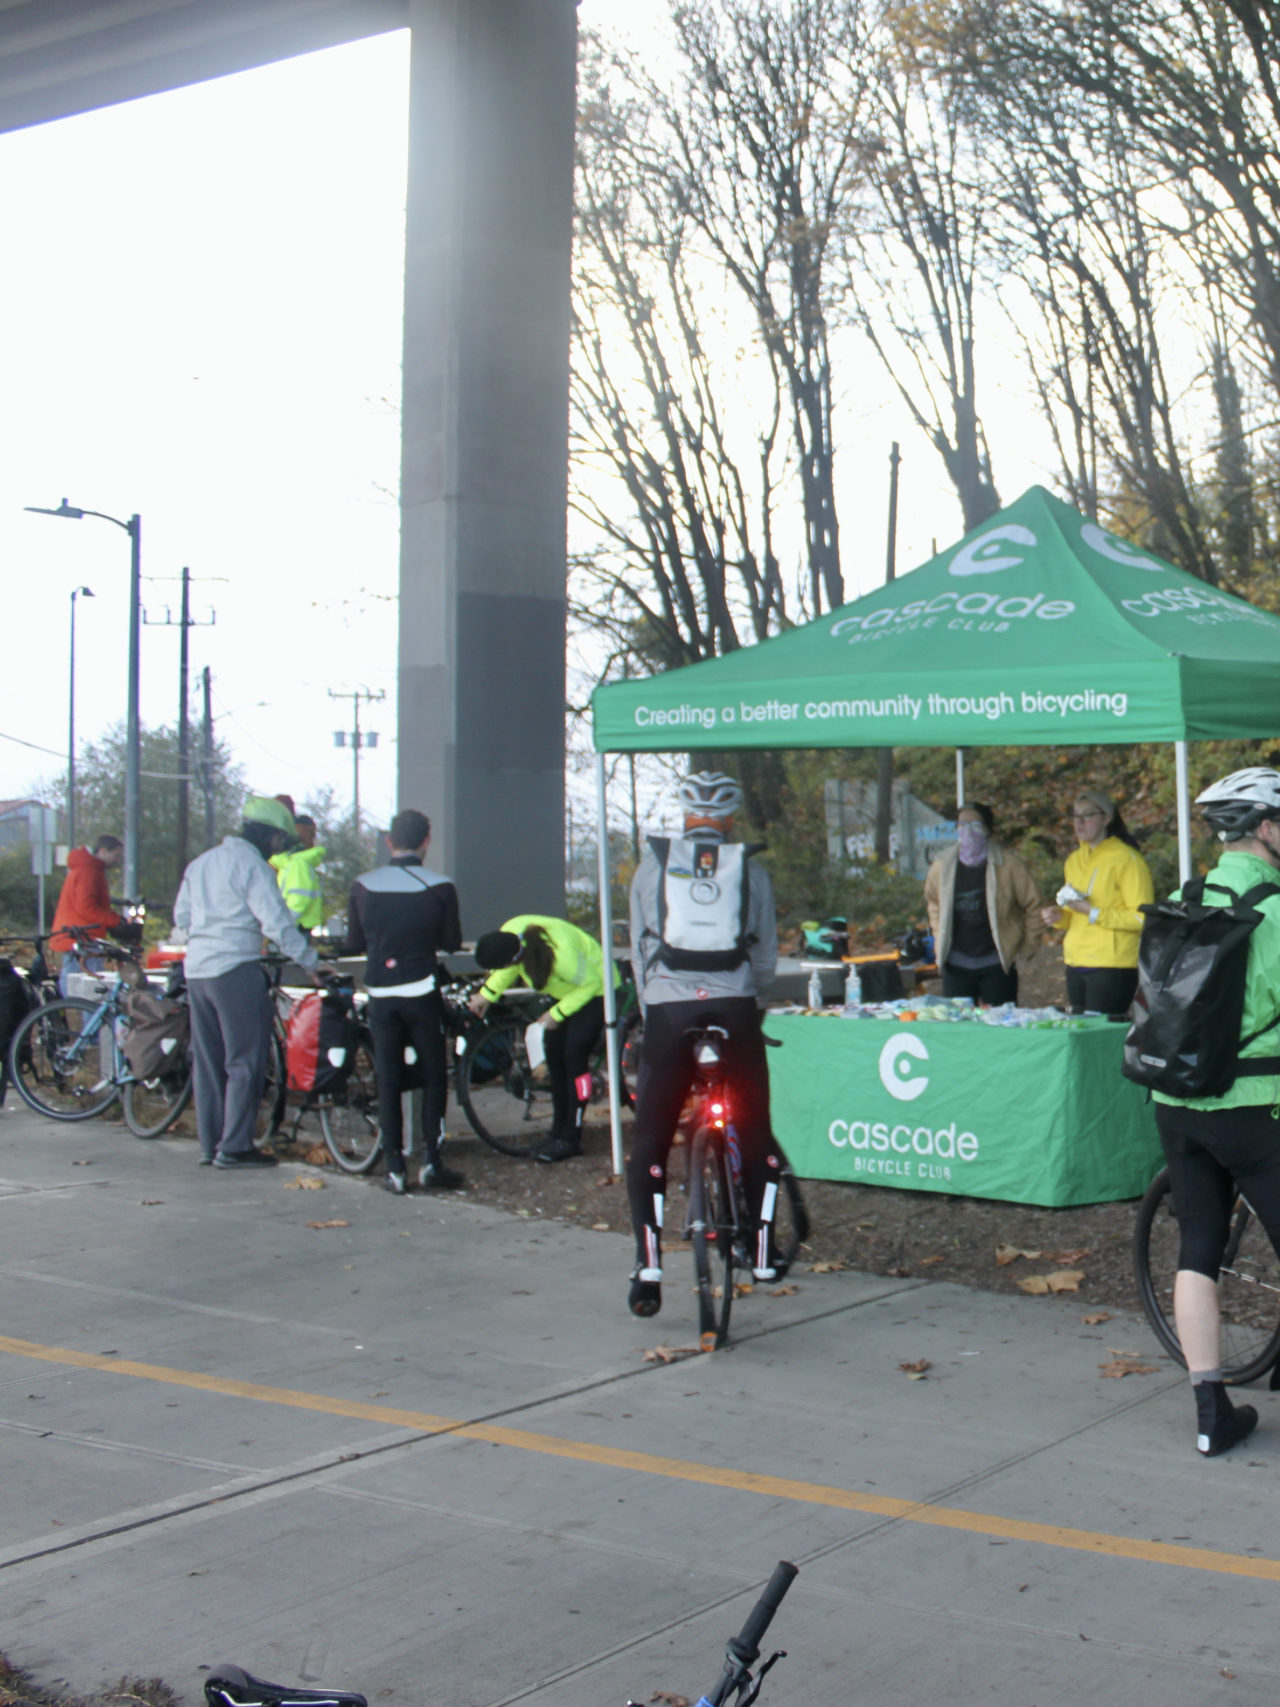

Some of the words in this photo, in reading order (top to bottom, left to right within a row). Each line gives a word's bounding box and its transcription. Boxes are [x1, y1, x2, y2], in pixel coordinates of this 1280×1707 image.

[830, 591, 1075, 637] cascade
[848, 616, 938, 645] BICYCLE
[947, 618, 1010, 633] CLUB
[634, 705, 716, 729] Creating
[721, 709, 735, 723] a
[740, 699, 798, 723] better
[804, 692, 921, 720] community
[927, 691, 1016, 718] through
[1022, 688, 1129, 717] bicycling
[828, 1119, 980, 1161] cascade
[853, 1157, 911, 1176] BICYCLE
[917, 1163, 952, 1181] CLUB
